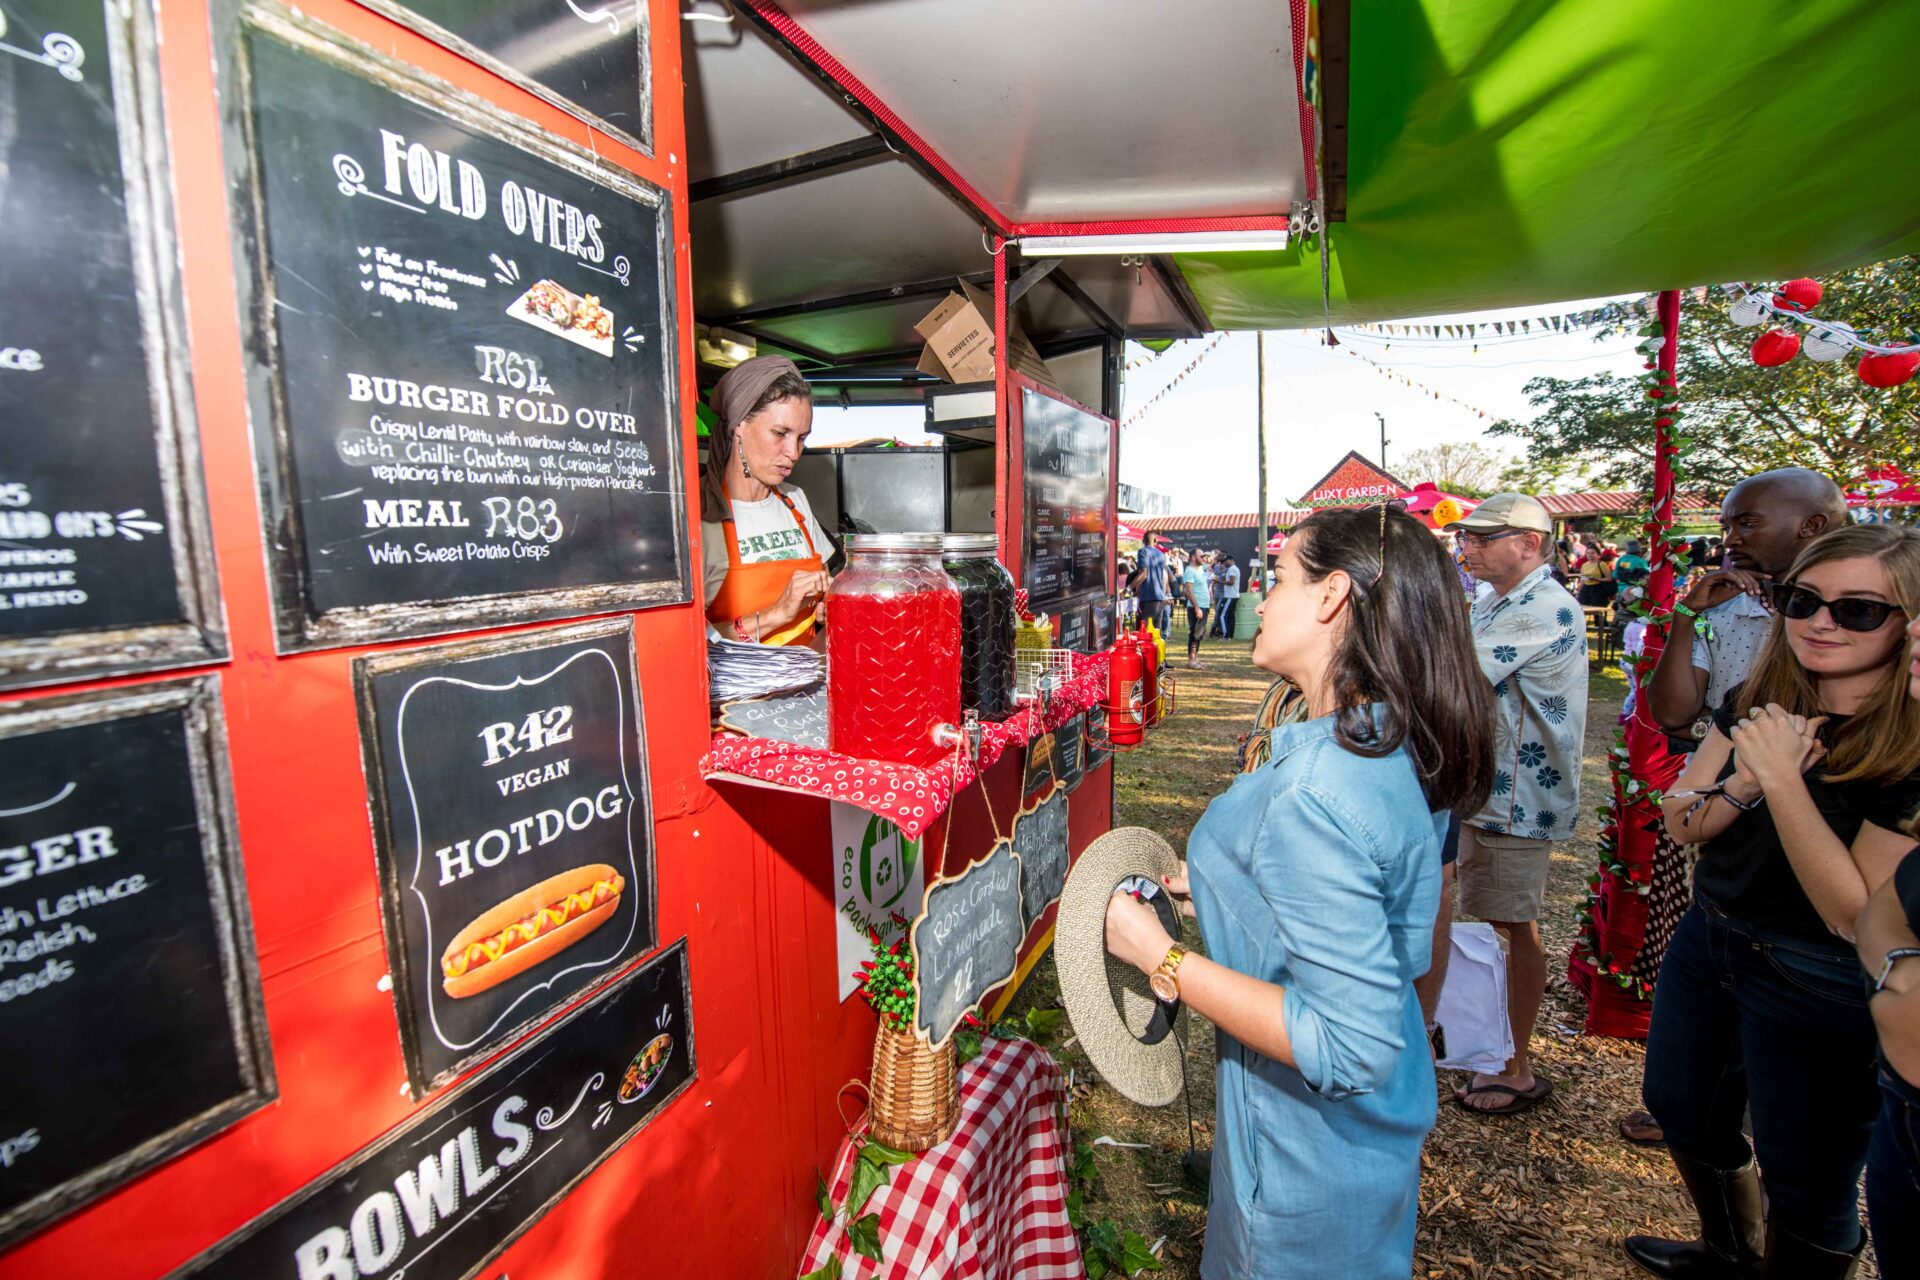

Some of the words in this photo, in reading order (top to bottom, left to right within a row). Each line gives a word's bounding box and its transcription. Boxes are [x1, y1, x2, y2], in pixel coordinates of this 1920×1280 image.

[380, 128, 487, 220] FOLD
[502, 181, 605, 263] OVERS
[0, 347, 44, 371] ce
[947, 328, 980, 359] SERVIETTES
[347, 373, 490, 417] BURGER
[498, 395, 569, 426] FOLD
[575, 408, 638, 435] OVER
[341, 436, 394, 457] with
[559, 454, 612, 474] Coriander
[614, 459, 656, 479] Yoghurt
[370, 415, 417, 440] Crispy
[418, 421, 456, 441] Lentil
[496, 430, 521, 448] with
[524, 435, 566, 451] rainbow
[592, 439, 611, 455] and
[371, 463, 438, 485] replacing
[441, 465, 464, 483] the
[466, 467, 492, 483] bun
[494, 469, 520, 485] with
[522, 476, 540, 486] our
[1313, 488, 1342, 501] LUXY
[1346, 485, 1397, 498] GARDEN
[363, 499, 470, 529] MEAL
[481, 496, 564, 543] R83
[368, 541, 412, 565] With
[414, 544, 463, 564] Sweet
[467, 543, 510, 561] Potato
[512, 541, 550, 563] Crisps
[477, 704, 573, 766] R42
[496, 759, 570, 797] VEGAN
[0, 826, 119, 888] GER
[435, 785, 623, 887] HOTDOG
[843, 846, 854, 890] eco
[37, 874, 149, 922] Lettuce
[934, 899, 967, 946] Rose
[970, 866, 1012, 907] Cordial
[934, 903, 1003, 985] Lemonade
[294, 1094, 534, 1280] BOWLS
